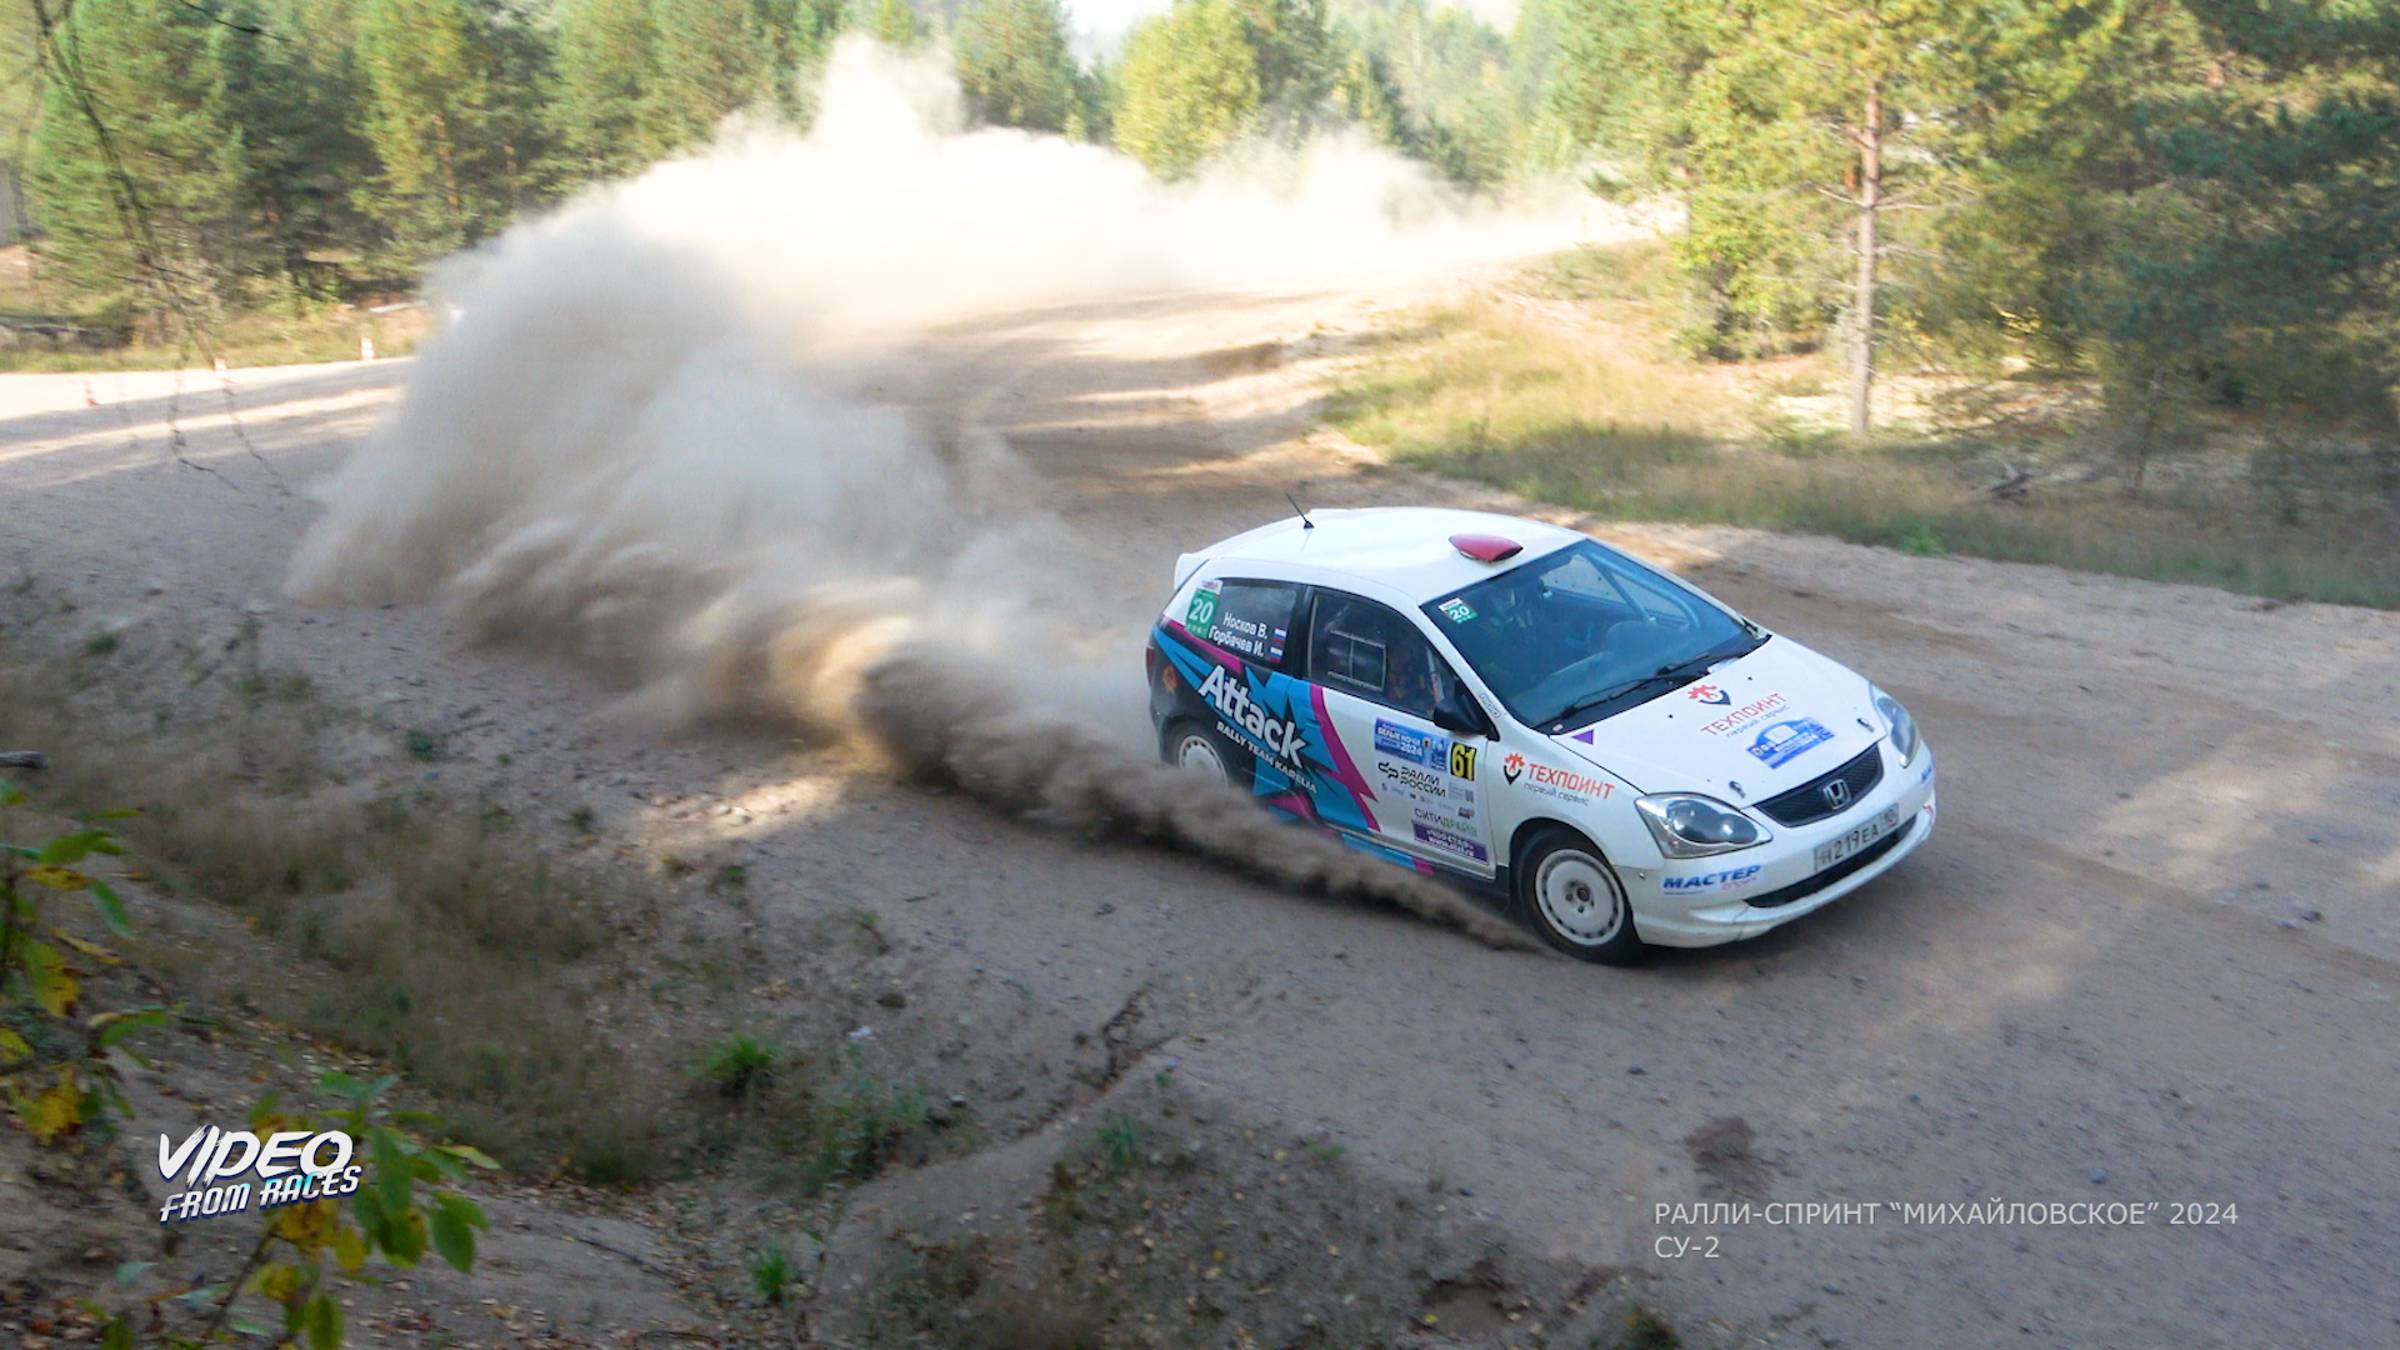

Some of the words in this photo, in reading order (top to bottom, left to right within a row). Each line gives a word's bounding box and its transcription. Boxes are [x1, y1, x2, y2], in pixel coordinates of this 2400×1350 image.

[1189, 598, 1214, 624] 20
[1223, 612, 1256, 635] Носков
[1256, 622, 1268, 640] В.
[1449, 605, 1470, 621] 20
[1208, 624, 1253, 653] Горбачев
[1252, 639, 1265, 657] И.
[1198, 665, 1307, 769] Attack
[1216, 721, 1250, 747] RALLY
[1248, 741, 1276, 764] TEAM
[1274, 760, 1318, 794] KARELIA
[1451, 743, 1477, 781] 61
[1663, 864, 1762, 889] МАСТЕР
